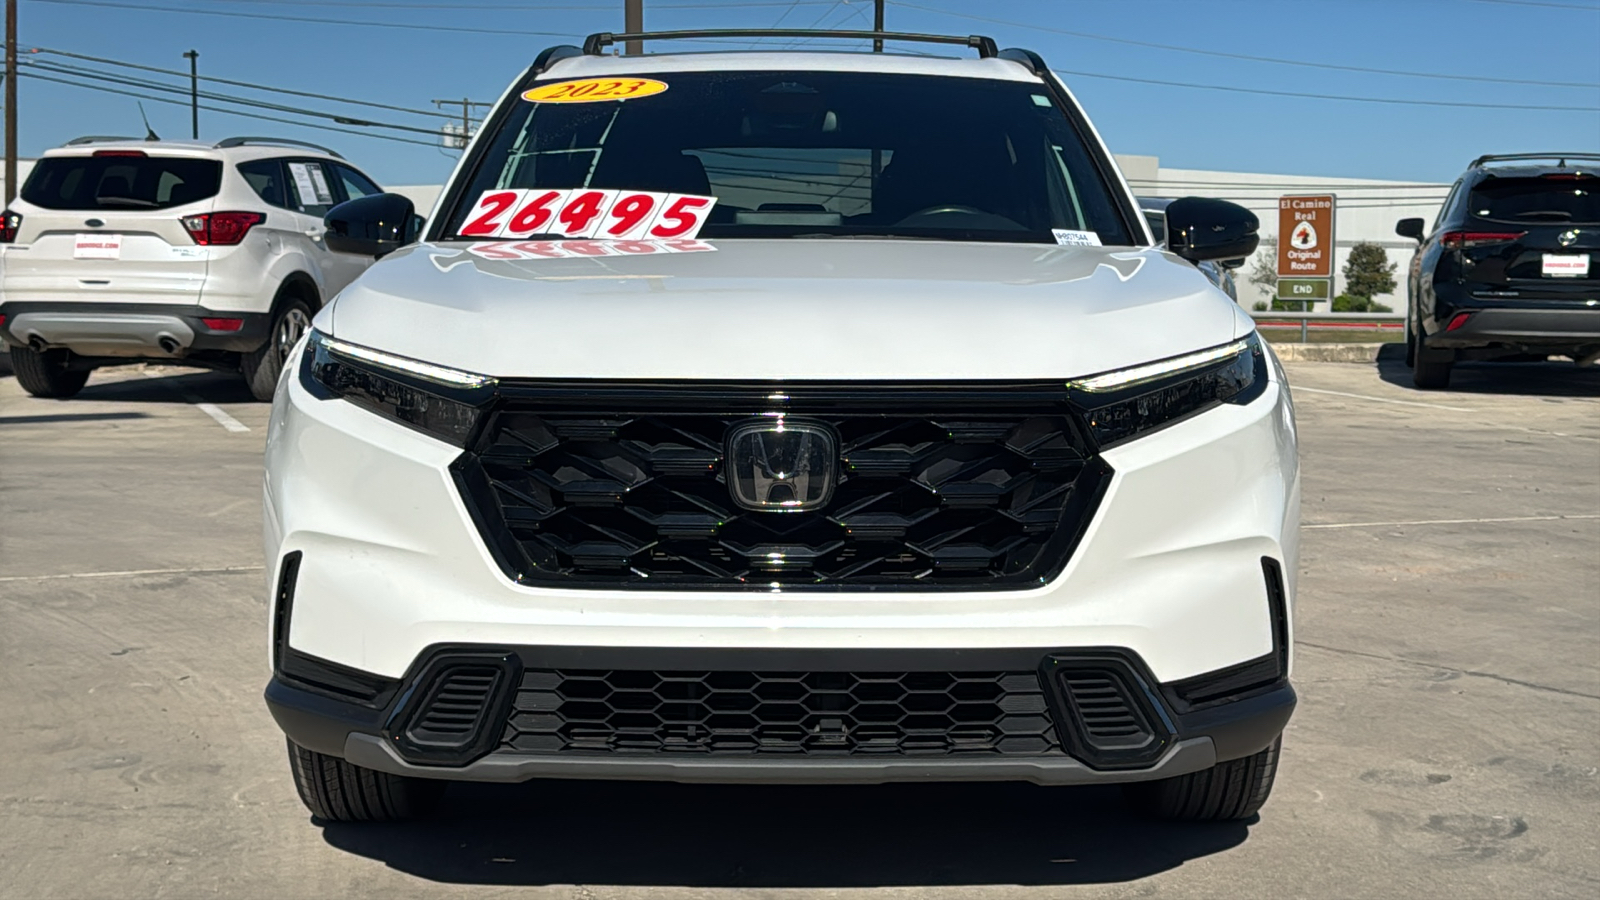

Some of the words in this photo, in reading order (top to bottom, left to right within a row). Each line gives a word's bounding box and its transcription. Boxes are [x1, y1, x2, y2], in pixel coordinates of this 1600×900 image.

[542, 81, 647, 99] 2023
[1281, 200, 1291, 209] El
[1292, 199, 1331, 209] Camino
[460, 190, 710, 237] 26495
[1294, 211, 1317, 221] Real
[1287, 250, 1322, 261] Original
[1290, 261, 1317, 270] Route
[1293, 285, 1313, 294] END
